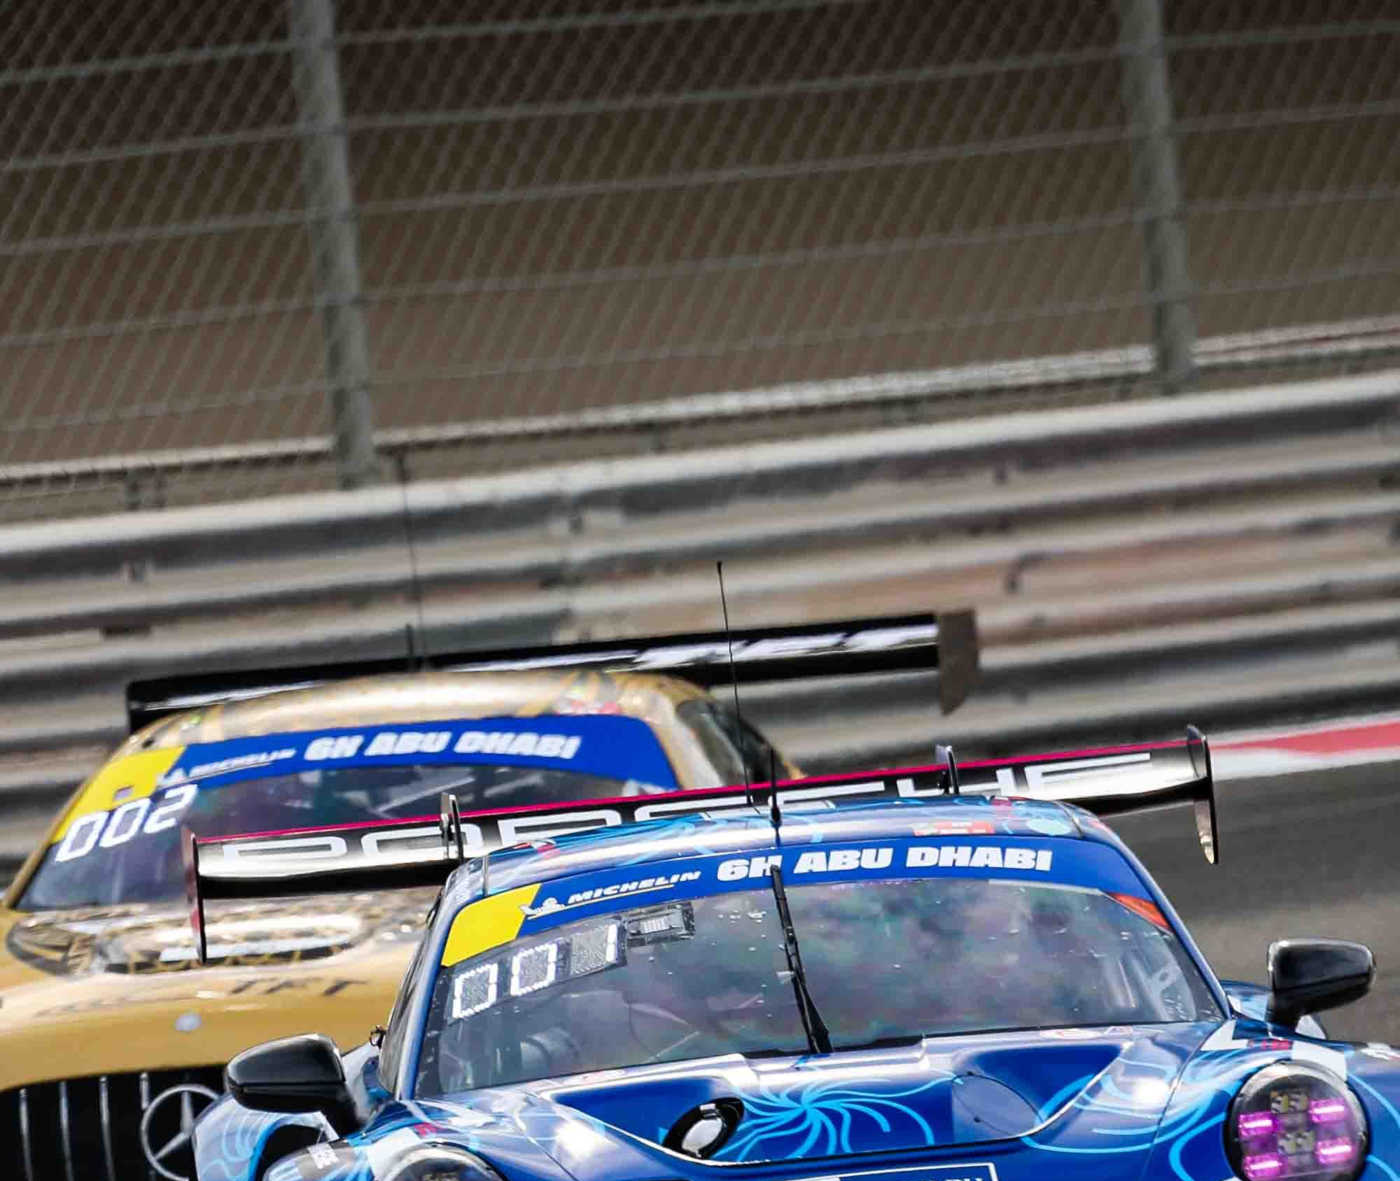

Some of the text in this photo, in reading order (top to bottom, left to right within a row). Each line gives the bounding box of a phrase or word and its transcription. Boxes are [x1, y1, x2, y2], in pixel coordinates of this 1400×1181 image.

[363, 730, 452, 757] ABU
[454, 730, 582, 760] DHABI
[55, 783, 199, 863] 002
[567, 845, 1054, 906] MICHELIN 6H ABU DHABI
[452, 922, 619, 1020] 001
